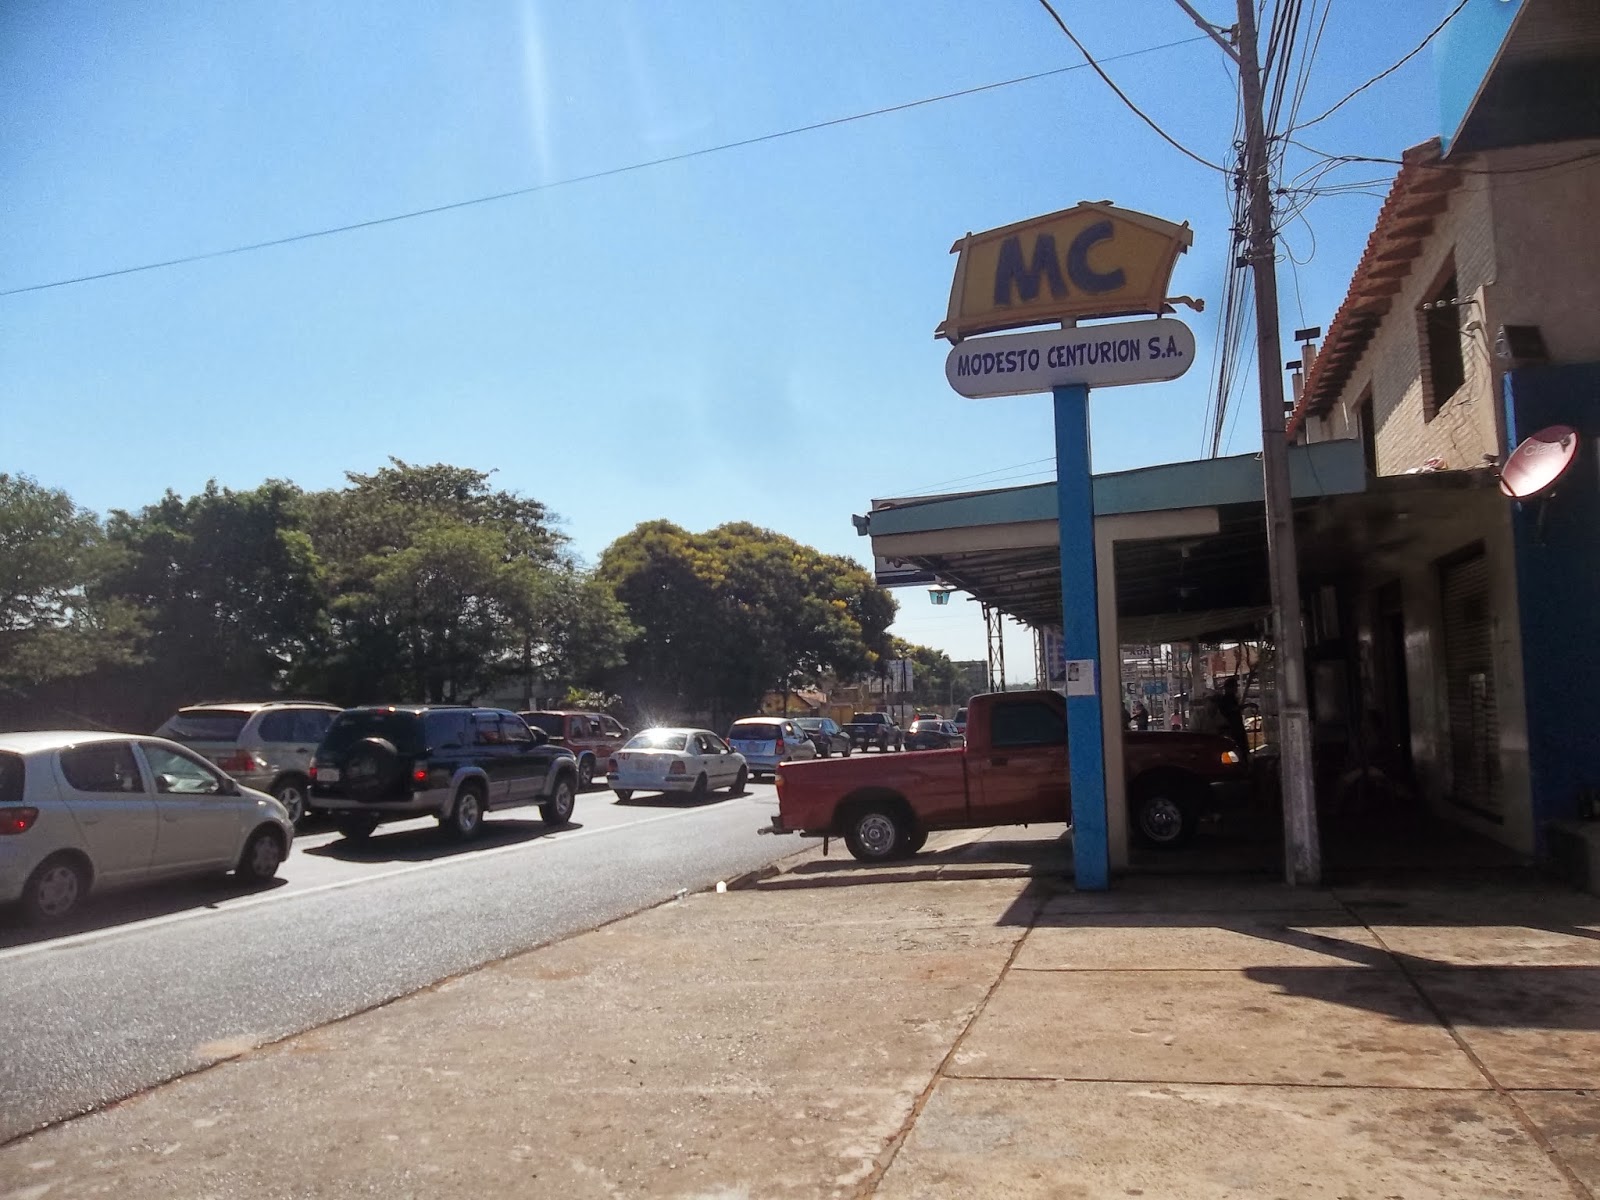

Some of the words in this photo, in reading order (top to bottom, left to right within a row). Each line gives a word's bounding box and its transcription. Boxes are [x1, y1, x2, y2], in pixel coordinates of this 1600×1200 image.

[993, 219, 1126, 306] MC
[957, 349, 1040, 377] MODESTO
[1047, 339, 1140, 368] CENTURION
[1148, 335, 1183, 360] S.A.
